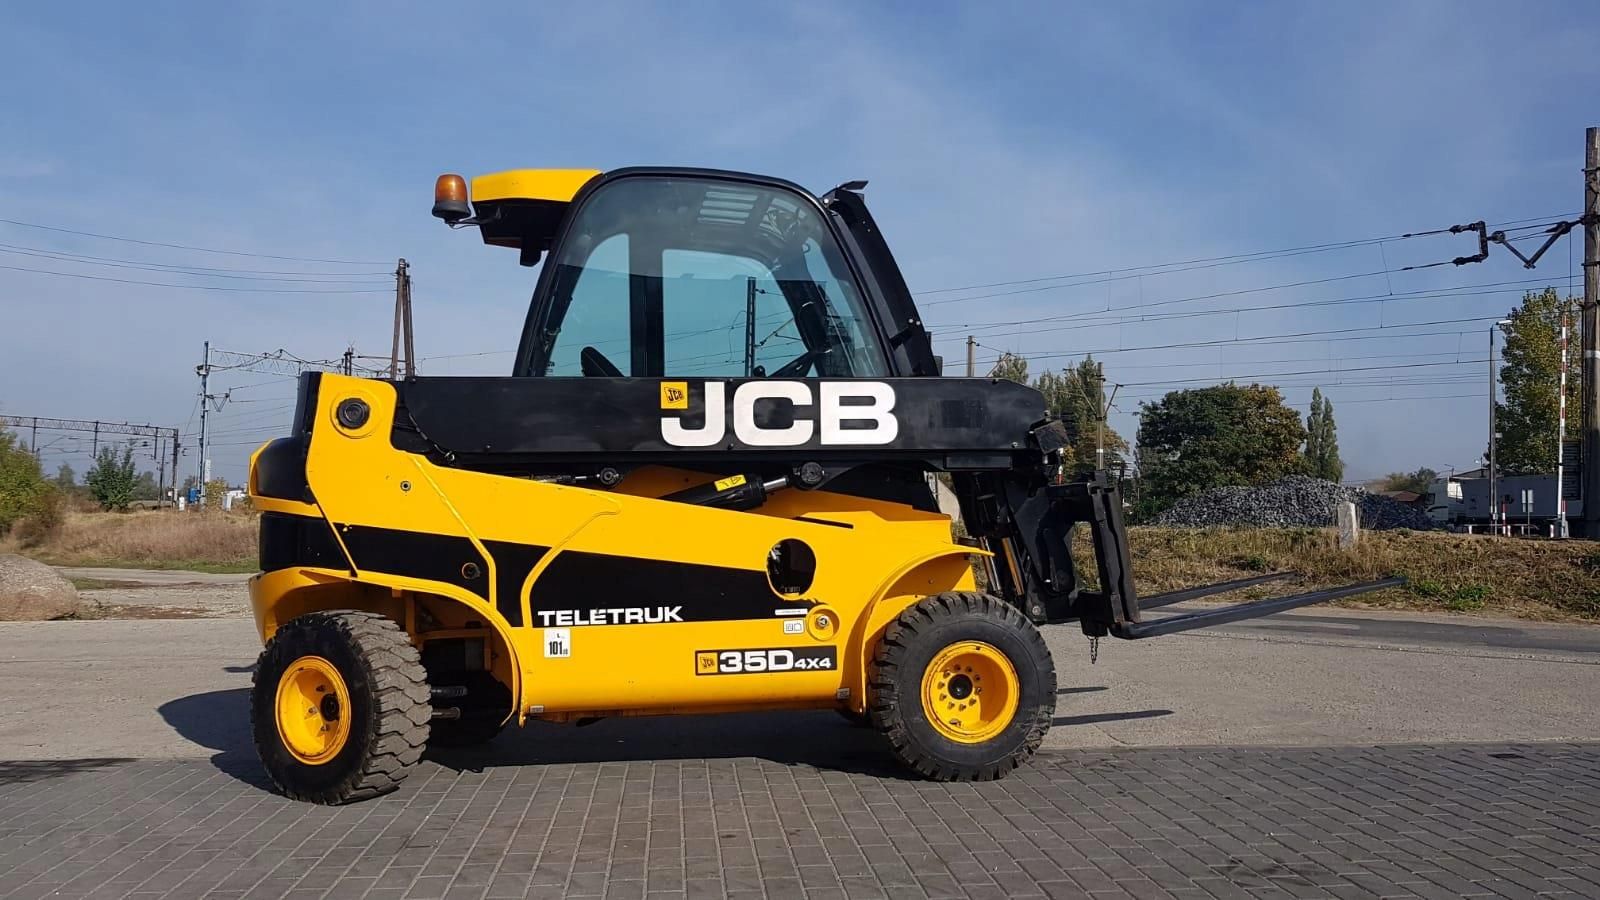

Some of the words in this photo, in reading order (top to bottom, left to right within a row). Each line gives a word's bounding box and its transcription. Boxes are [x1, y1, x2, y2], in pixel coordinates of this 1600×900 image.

[661, 381, 898, 447] JCB
[538, 605, 683, 626] TELETRUK
[549, 640, 563, 655] 101
[720, 650, 793, 672] 35D
